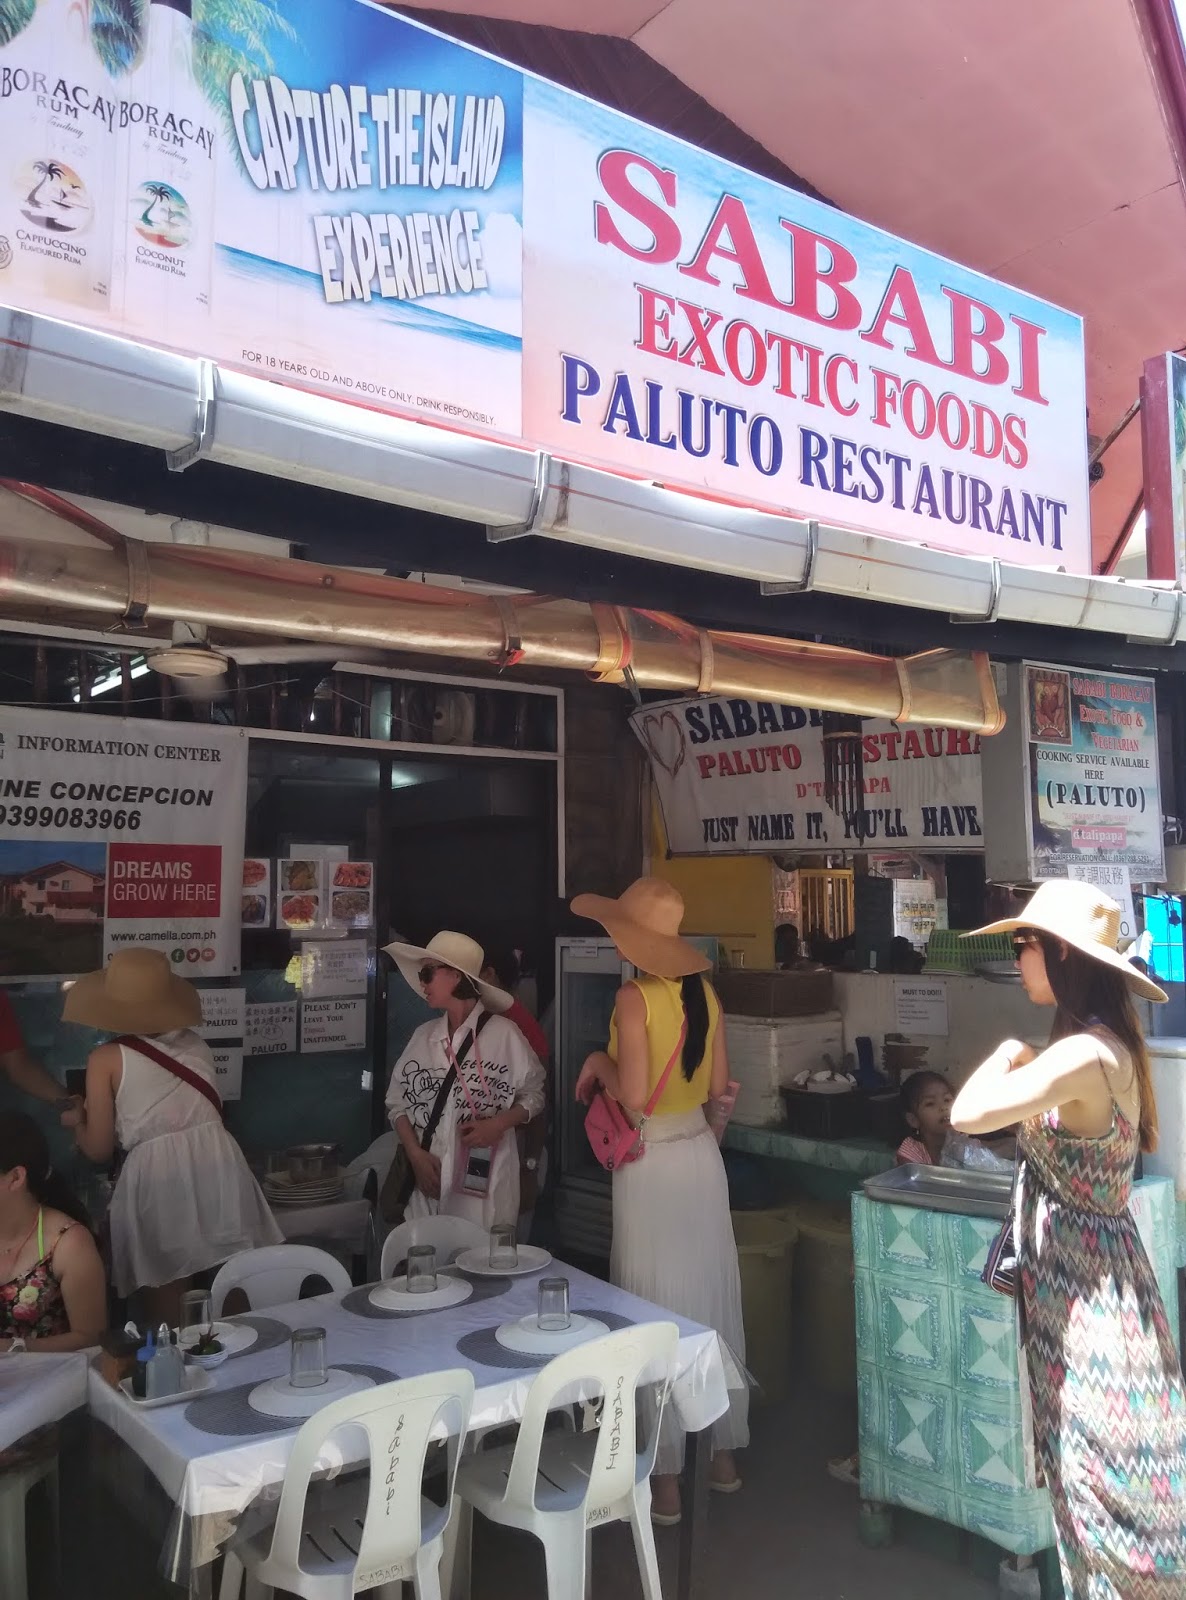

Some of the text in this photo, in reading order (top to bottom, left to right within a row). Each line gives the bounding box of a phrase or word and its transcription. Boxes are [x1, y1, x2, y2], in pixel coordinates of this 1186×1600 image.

[1, 67, 117, 133] BORACAY
[36, 95, 79, 119] RUM
[119, 100, 215, 160] BORACAY
[149, 126, 184, 148] RUM
[230, 72, 505, 191] CAPTURE THE ISLAND
[16, 229, 87, 257] CAPPUCCINO
[136, 245, 186, 268] COCONUT
[313, 208, 488, 303] EXPERIENCE
[594, 147, 1049, 407] SABABI
[242, 349, 262, 363] FOR
[265, 355, 276, 367] 18
[279, 359, 307, 376] YEARS
[310, 368, 330, 380] OLD
[332, 374, 353, 387] AND
[355, 381, 387, 396] ABOVE
[416, 396, 442, 411] DRINK
[635, 283, 1029, 470] EXOTIC FOODS
[559, 352, 1068, 551] PALUTO RESTAURANT
[1135, 711, 1144, 728] &
[17, 734, 149, 758] INFORMATION
[154, 744, 222, 763] CENTER
[1036, 750, 1150, 768] COOKING SERVICE AVAILABLE
[697, 743, 802, 779] PALUTO
[1085, 769, 1104, 780] HERE
[50, 781, 214, 807] CONCEPCION
[1046, 780, 1146, 813] (PALUTO)
[703, 816, 738, 843] JUST
[748, 812, 794, 841] NAME
[806, 812, 828, 842] IT,
[922, 805, 982, 836] HAVE
[113, 861, 193, 879] DREAMS
[113, 883, 217, 901] GROW HERE
[111, 929, 217, 942] www.camella.com.ph
[304, 1004, 331, 1012] PLEASE
[304, 1016, 323, 1024] LEAVE
[207, 1018, 238, 1027] PALUTO
[213, 1055, 230, 1063] OOD
[251, 1043, 287, 1054] PALUTO
[359, 1564, 404, 1588] SABABI
